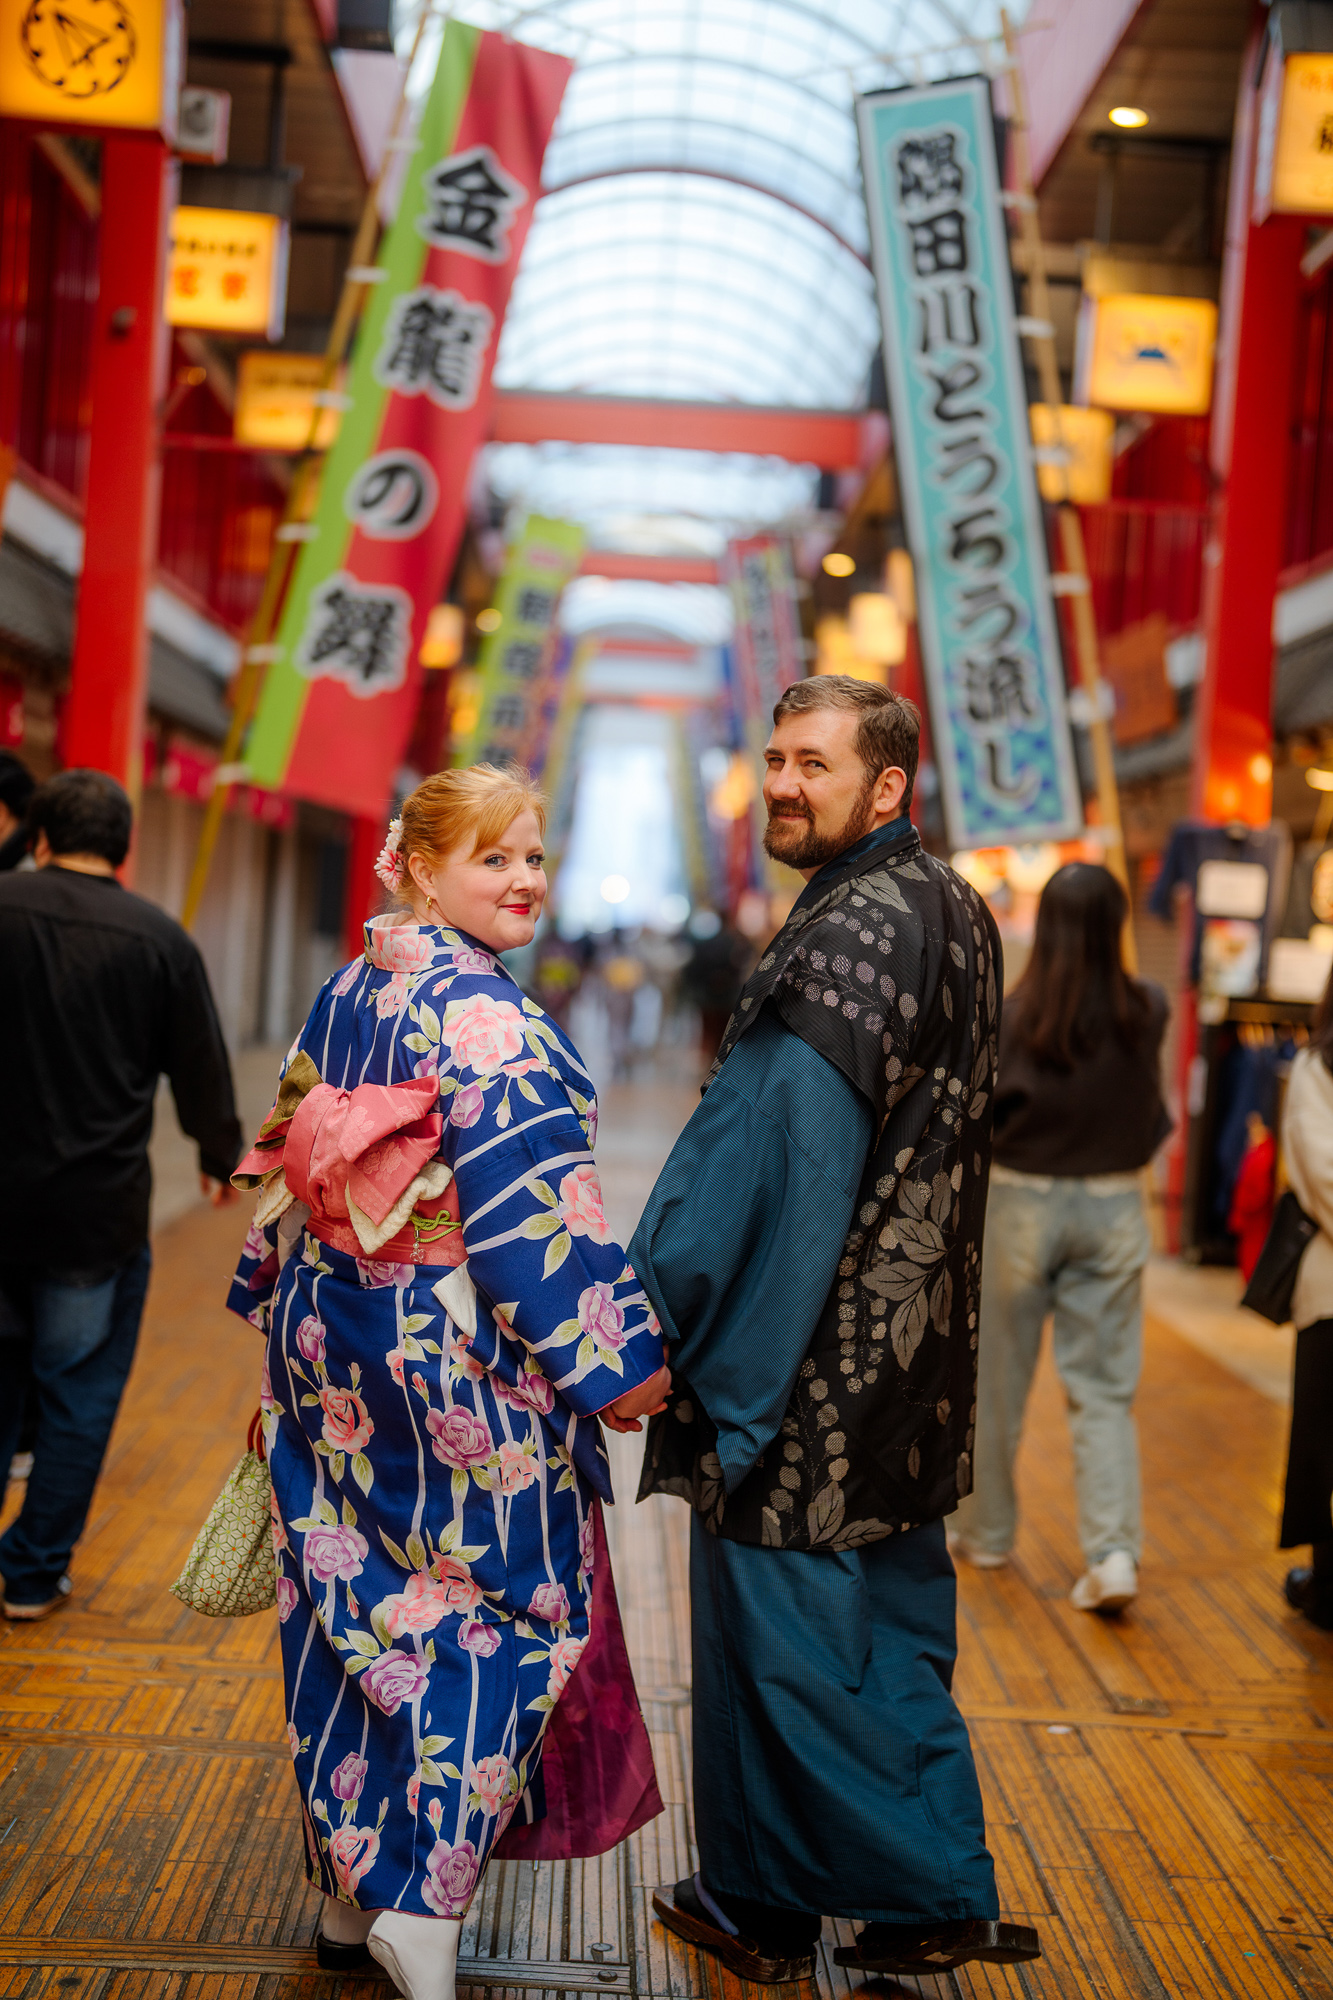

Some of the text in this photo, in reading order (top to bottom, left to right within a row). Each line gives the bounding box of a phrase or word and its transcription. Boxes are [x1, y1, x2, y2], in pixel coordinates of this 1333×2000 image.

[310, 157, 511, 678] 金龍の舞
[898, 132, 1038, 798] 隅田川とうろう流し
